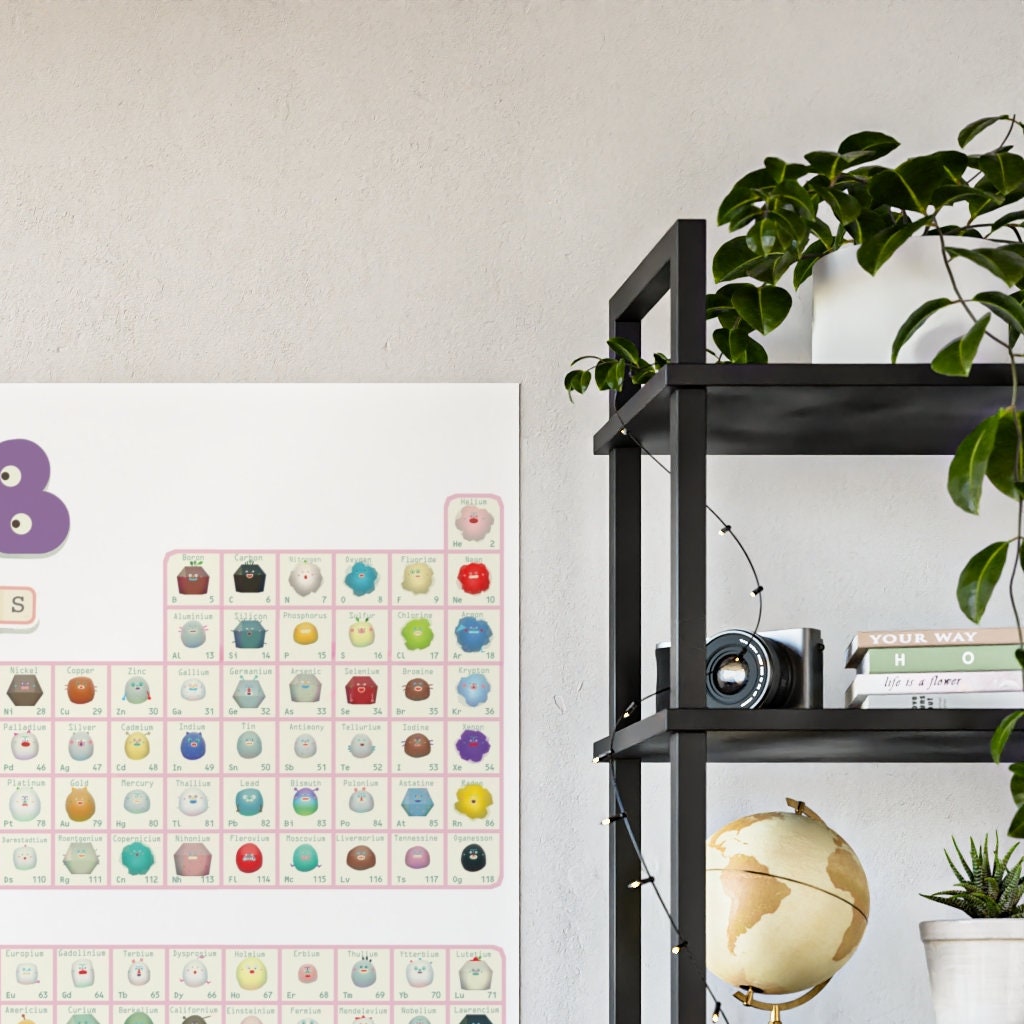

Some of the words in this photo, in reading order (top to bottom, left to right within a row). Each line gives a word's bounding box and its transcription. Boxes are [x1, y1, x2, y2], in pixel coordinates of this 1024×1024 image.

[869, 633, 927, 645] YOUR
[934, 631, 978, 643] WAY
[895, 653, 906, 667] H
[962, 651, 975, 665] O
[884, 676, 901, 691] life
[905, 678, 914, 687] is
[918, 679, 925, 687] a
[926, 675, 963, 690] flower
